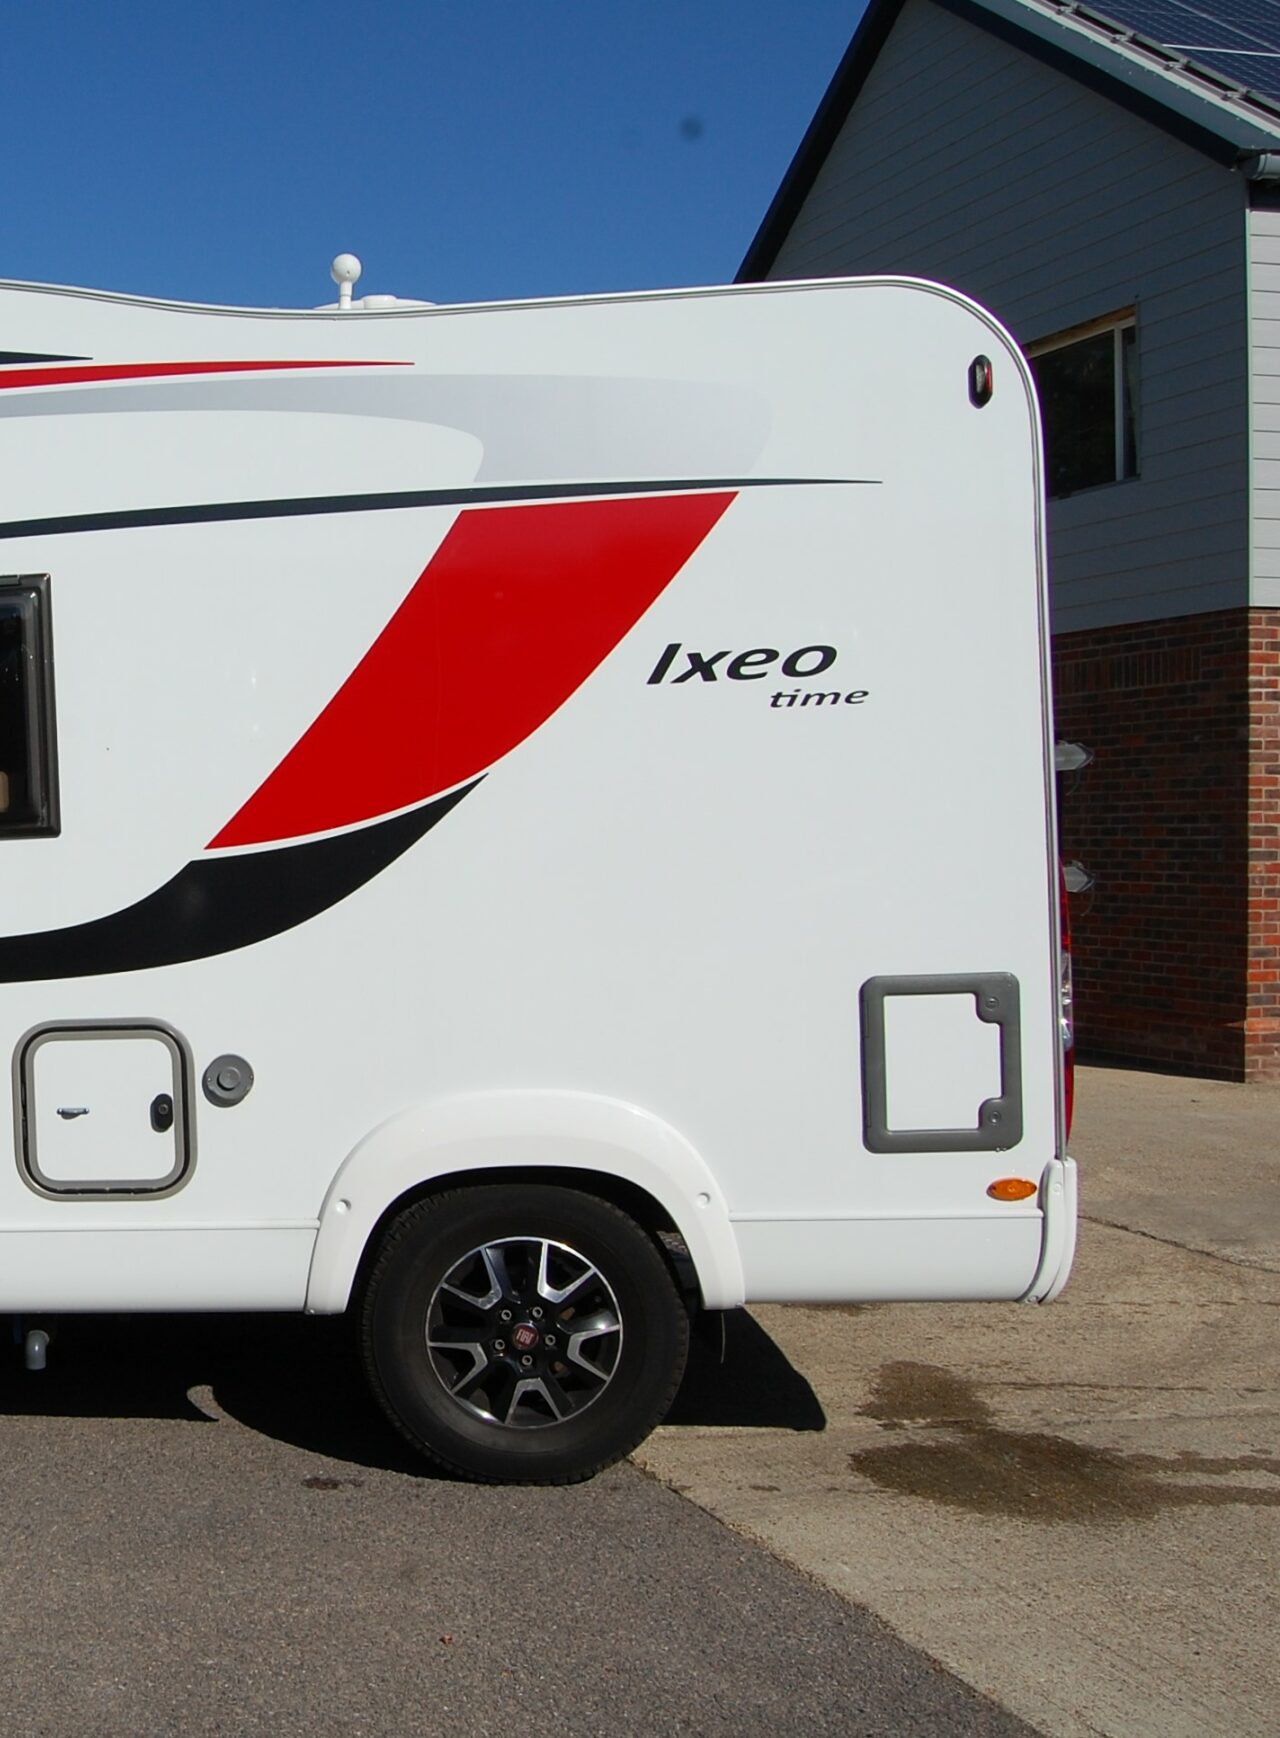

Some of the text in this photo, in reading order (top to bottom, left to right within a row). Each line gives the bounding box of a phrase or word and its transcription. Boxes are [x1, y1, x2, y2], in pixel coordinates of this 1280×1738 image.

[647, 643, 837, 685] Ixeo
[770, 689, 869, 708] time
[516, 1328, 534, 1345] FIAT
